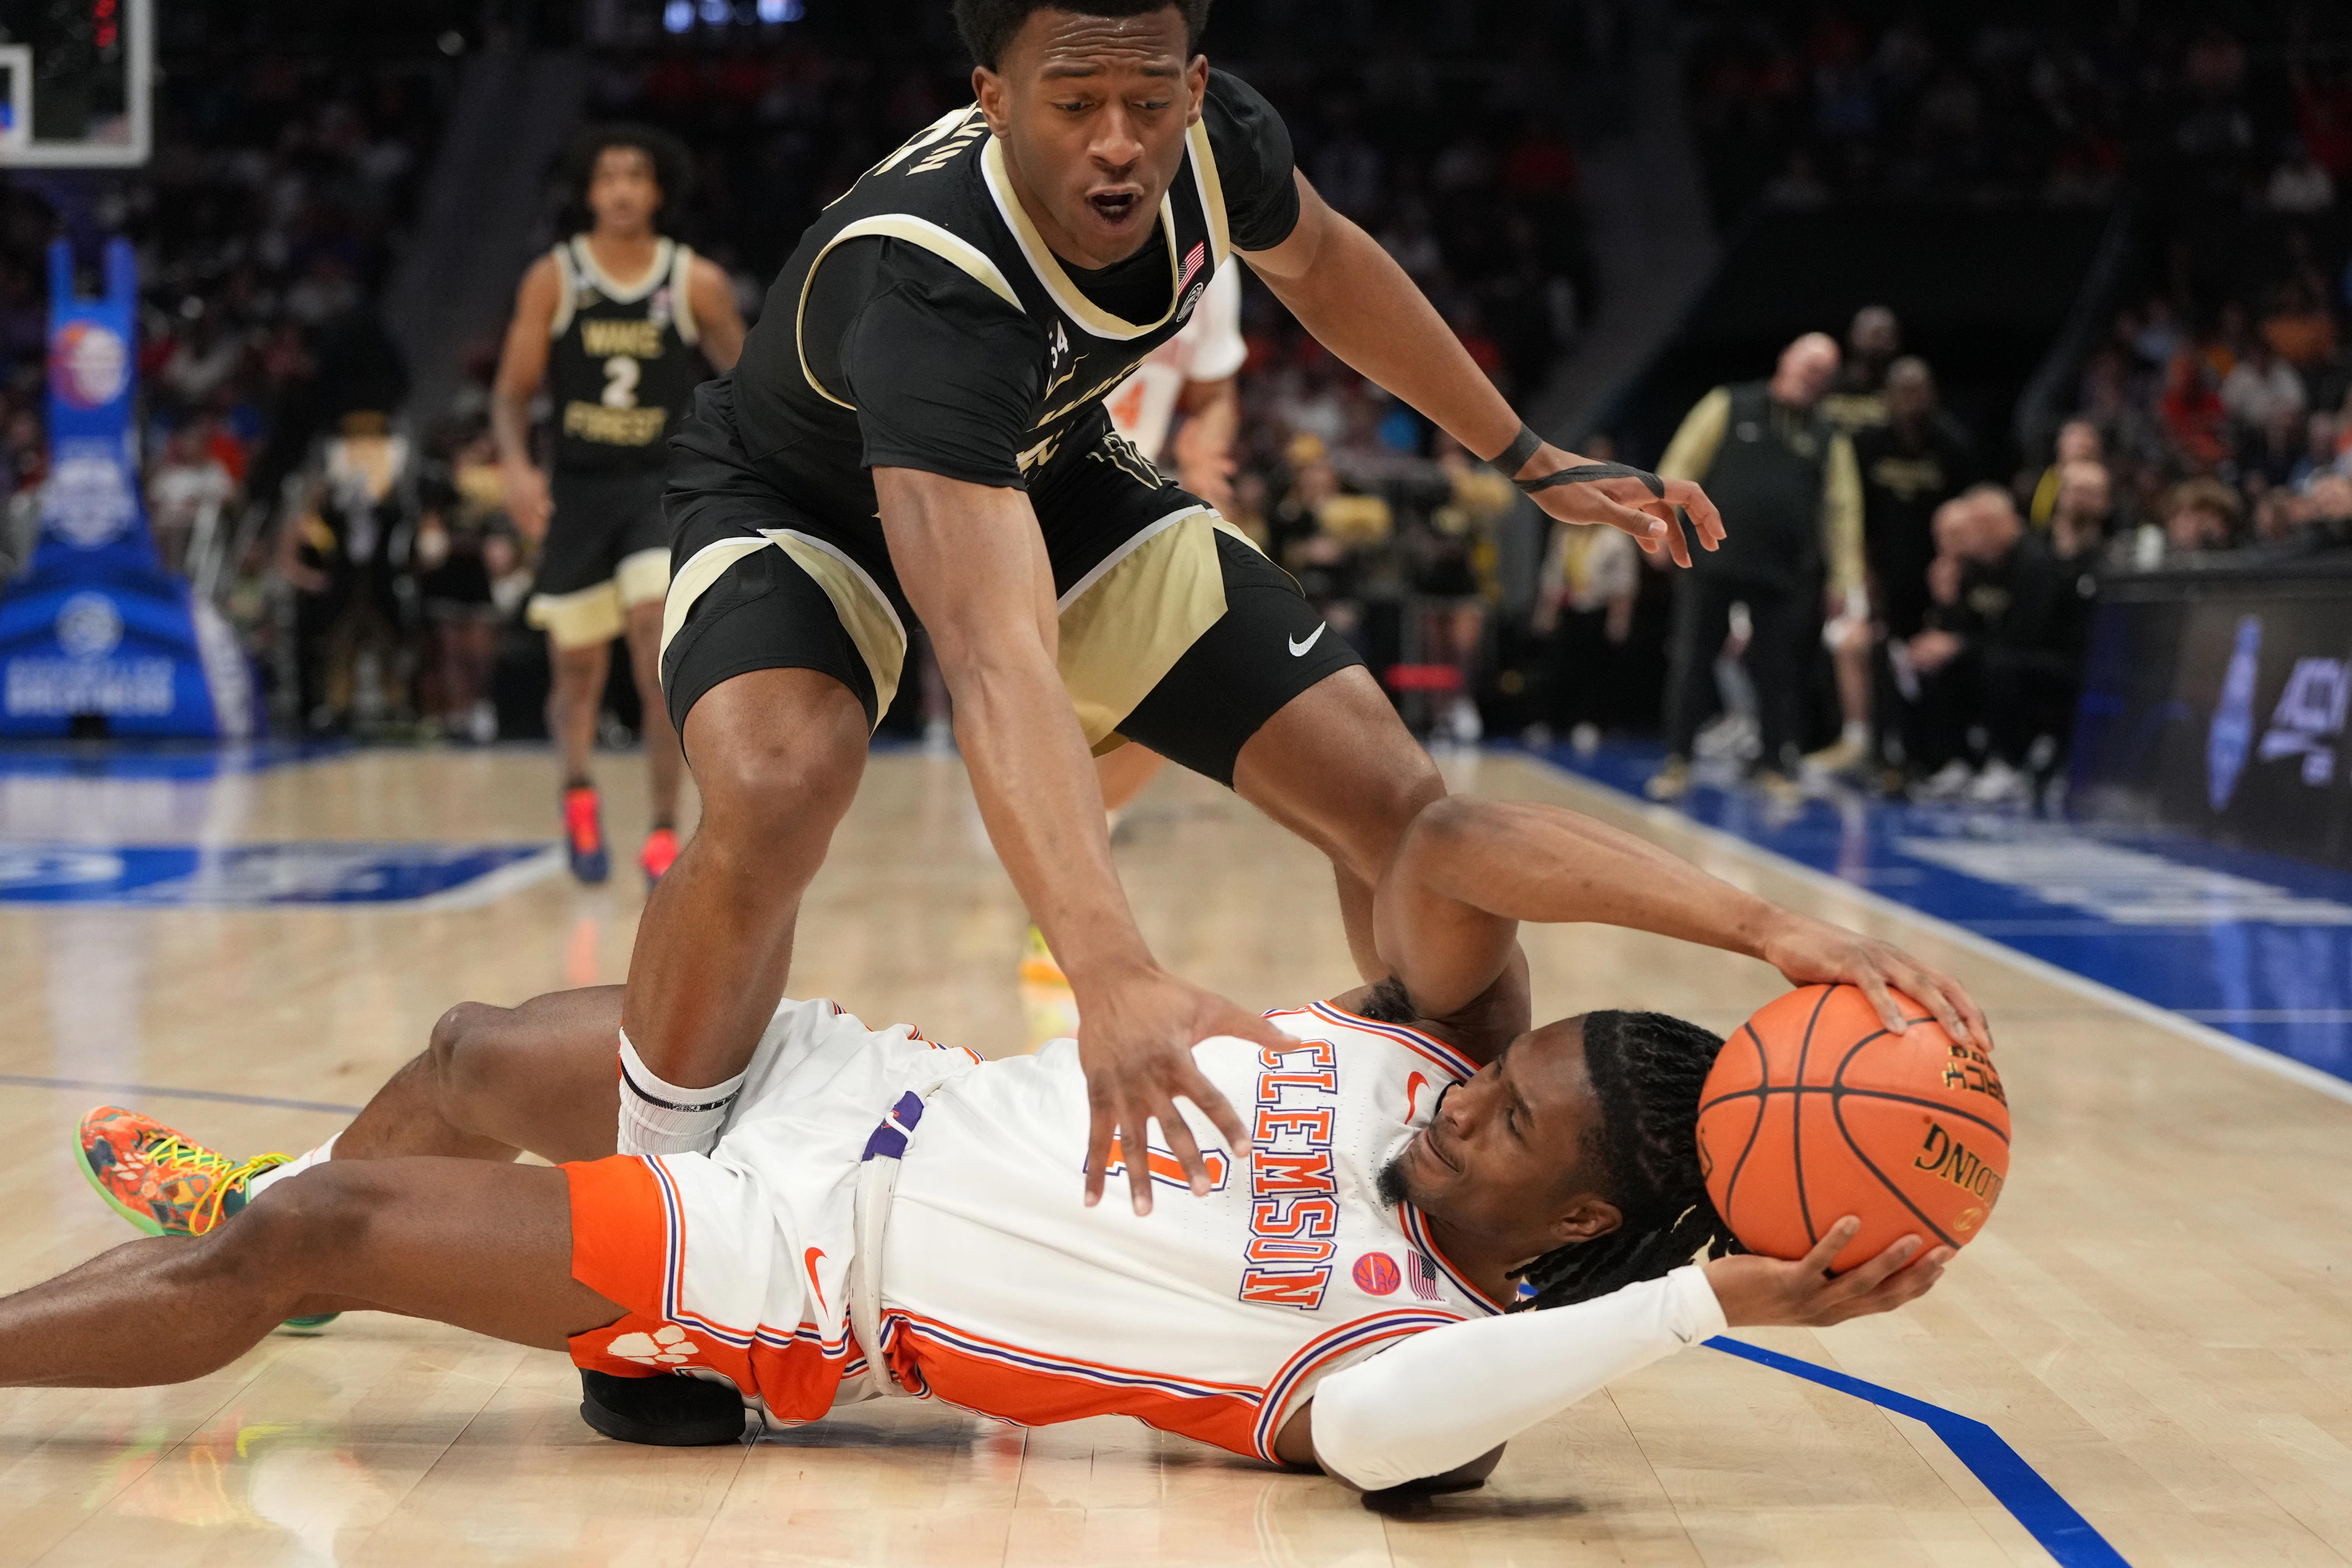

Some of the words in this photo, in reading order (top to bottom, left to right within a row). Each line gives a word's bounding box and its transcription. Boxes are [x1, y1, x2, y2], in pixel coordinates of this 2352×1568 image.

[601, 356, 641, 409] 2
[1239, 1038, 1339, 1310] CLEMSON
[1914, 1122, 2004, 1207] LDING
